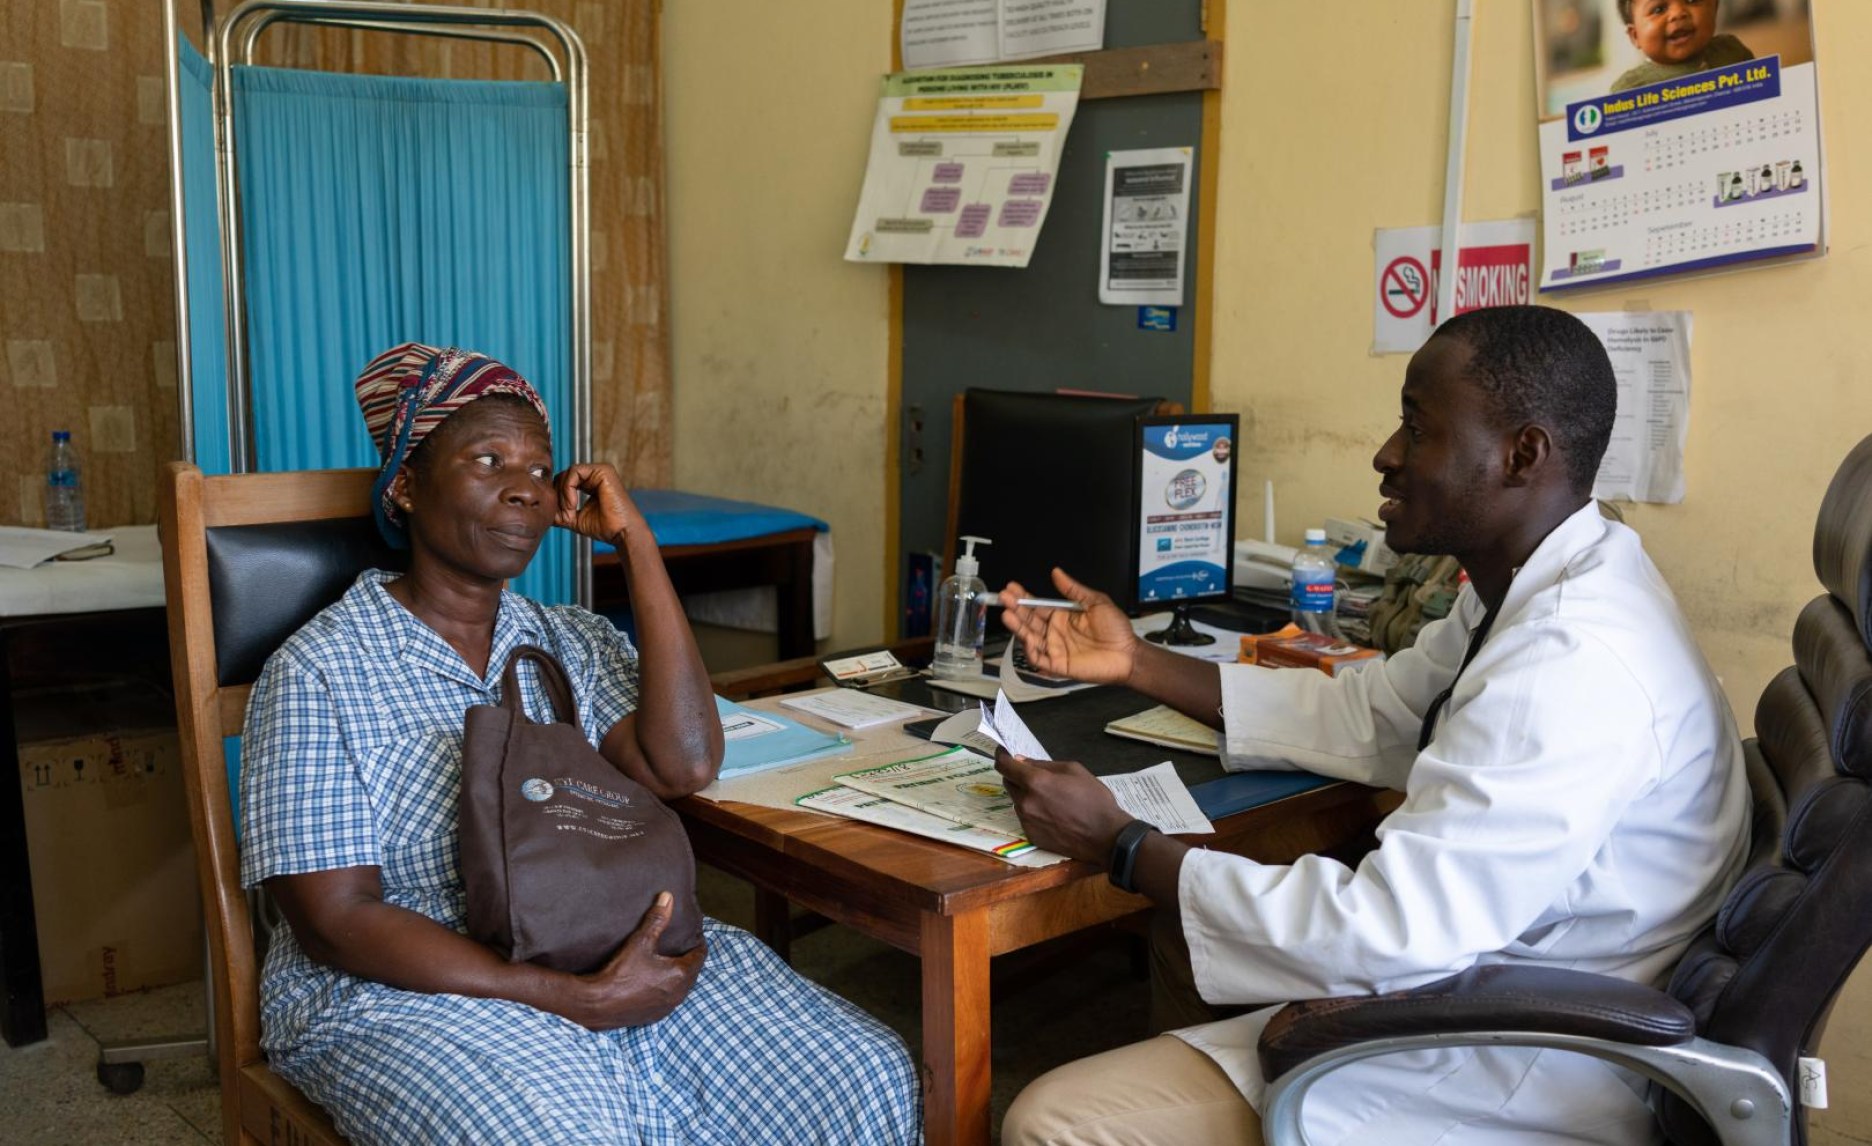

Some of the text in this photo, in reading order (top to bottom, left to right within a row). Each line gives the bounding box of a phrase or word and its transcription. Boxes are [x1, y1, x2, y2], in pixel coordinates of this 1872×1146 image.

[1603, 66, 1771, 114] Indus Life Sciences Pvt. Ltd.
[1456, 263, 1528, 308] SMOKING
[576, 781, 599, 793] CARE
